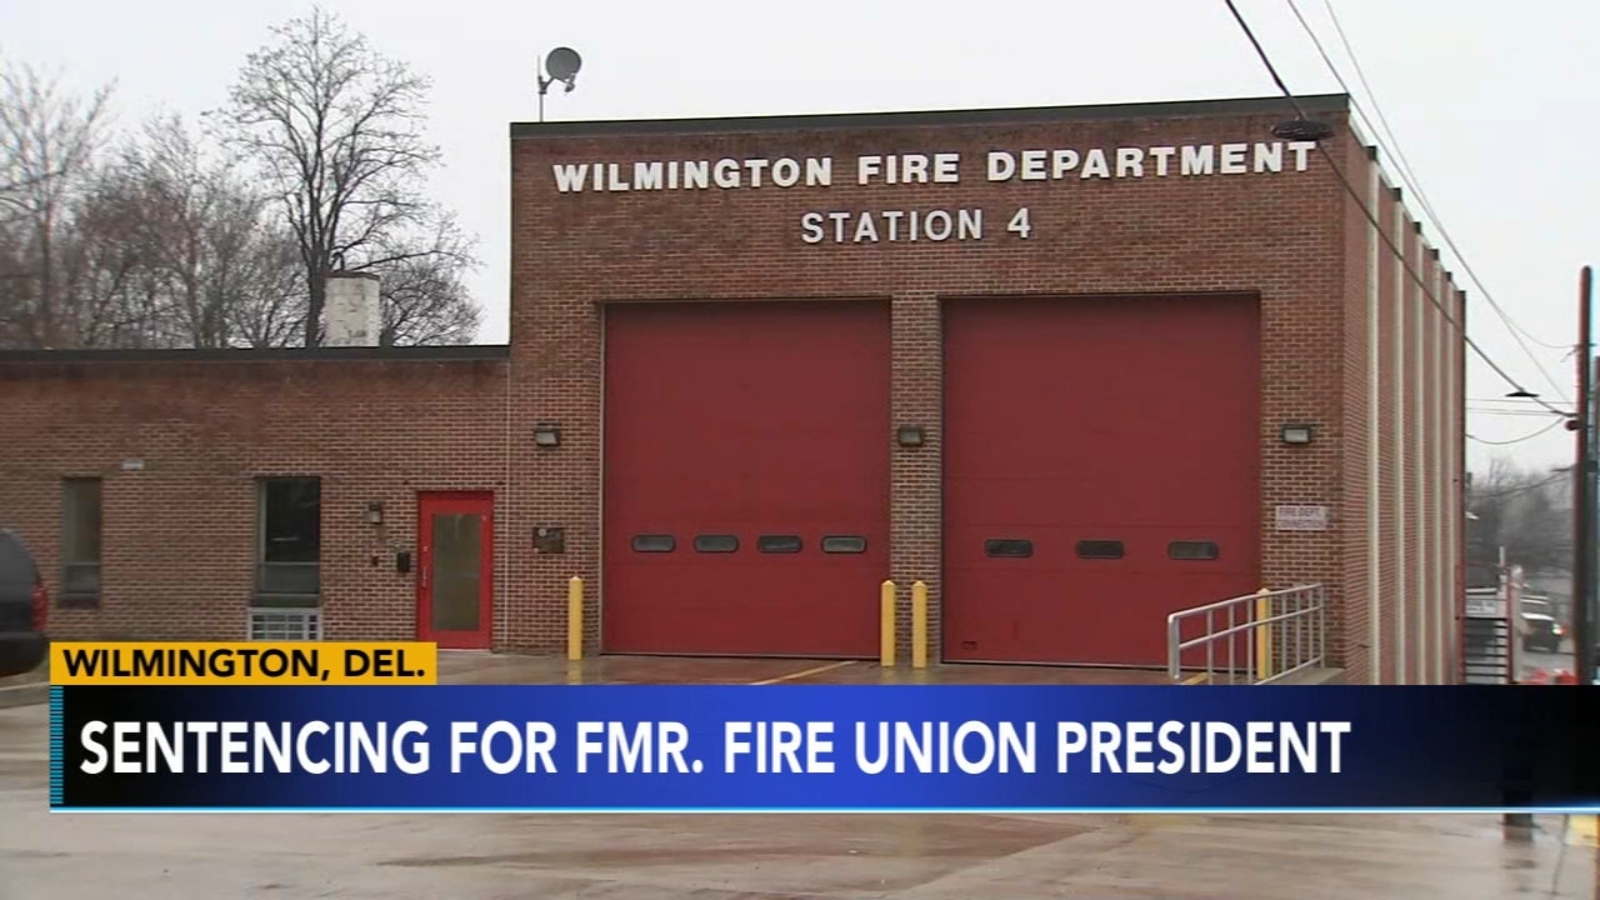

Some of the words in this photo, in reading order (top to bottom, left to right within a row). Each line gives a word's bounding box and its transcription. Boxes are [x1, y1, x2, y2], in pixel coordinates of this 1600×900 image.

[553, 156, 832, 193] WILMINGTON
[857, 153, 960, 185] FIRE
[987, 141, 1316, 182] DEPARTMENT
[801, 208, 983, 244] STATION
[1007, 207, 1032, 239] 4
